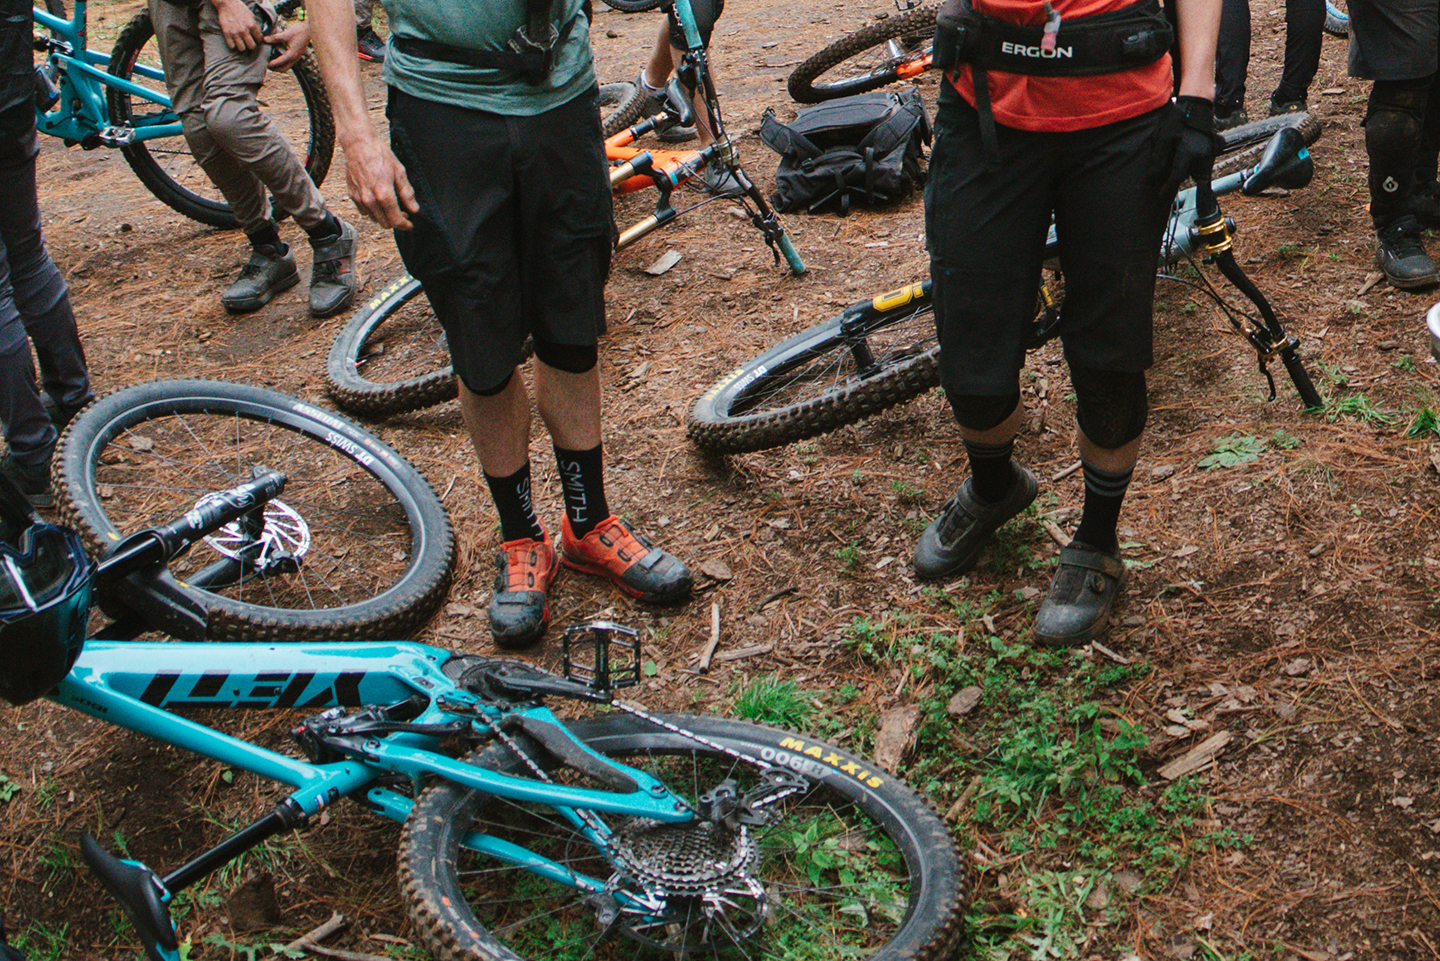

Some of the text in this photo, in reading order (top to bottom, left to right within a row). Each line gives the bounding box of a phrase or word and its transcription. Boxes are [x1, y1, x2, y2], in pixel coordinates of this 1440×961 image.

[1002, 41, 1073, 59] ERGON
[325, 431, 359, 455] SWISS
[354, 446, 375, 466] DT
[561, 461, 588, 523] SMITH
[138, 669, 368, 709] YETI
[779, 737, 885, 788] MAXXIS
